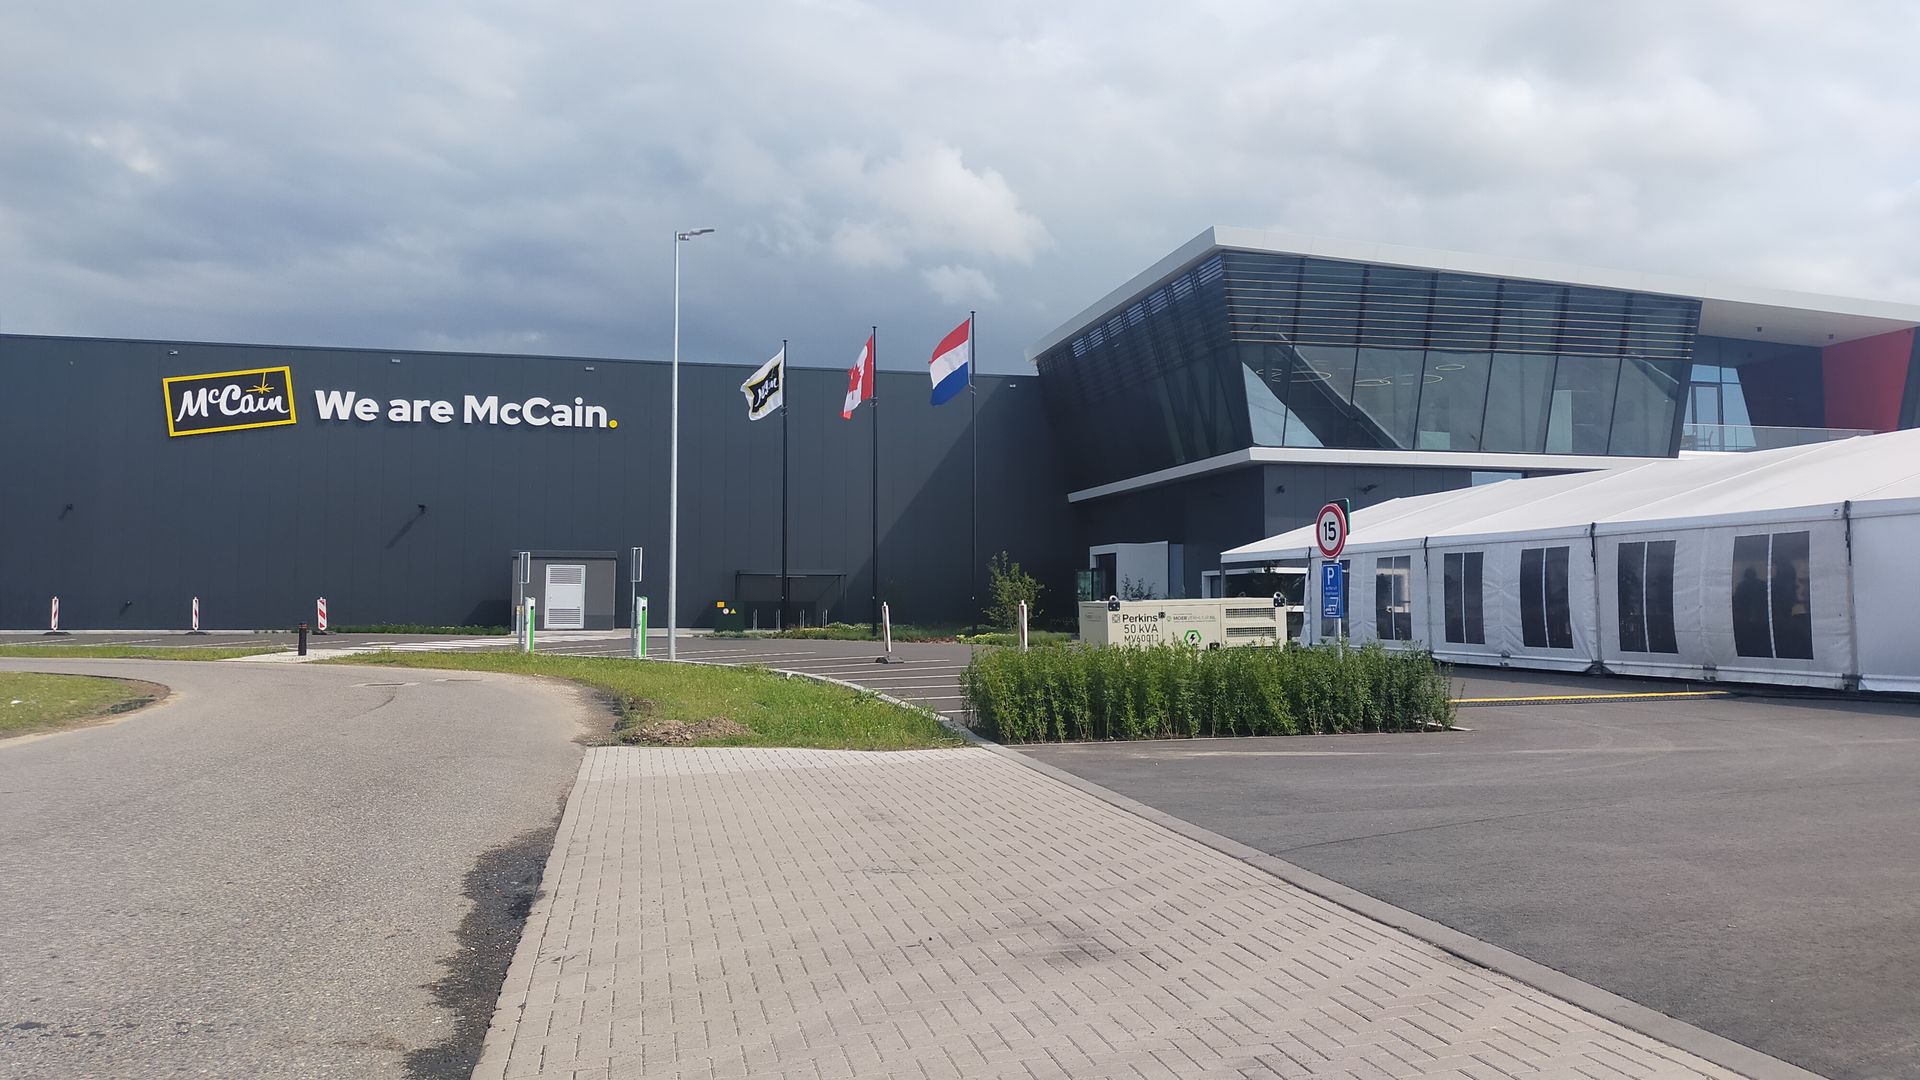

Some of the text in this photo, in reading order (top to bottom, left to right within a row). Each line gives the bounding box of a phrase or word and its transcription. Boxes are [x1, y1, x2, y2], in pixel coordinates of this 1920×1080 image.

[175, 384, 290, 422] McCain
[315, 390, 618, 429] We are McCain.
[1323, 521, 1337, 541] 15
[1327, 567, 1335, 585] P
[1122, 613, 1158, 623] Perkins
[1124, 624, 1159, 634] 50 kVA
